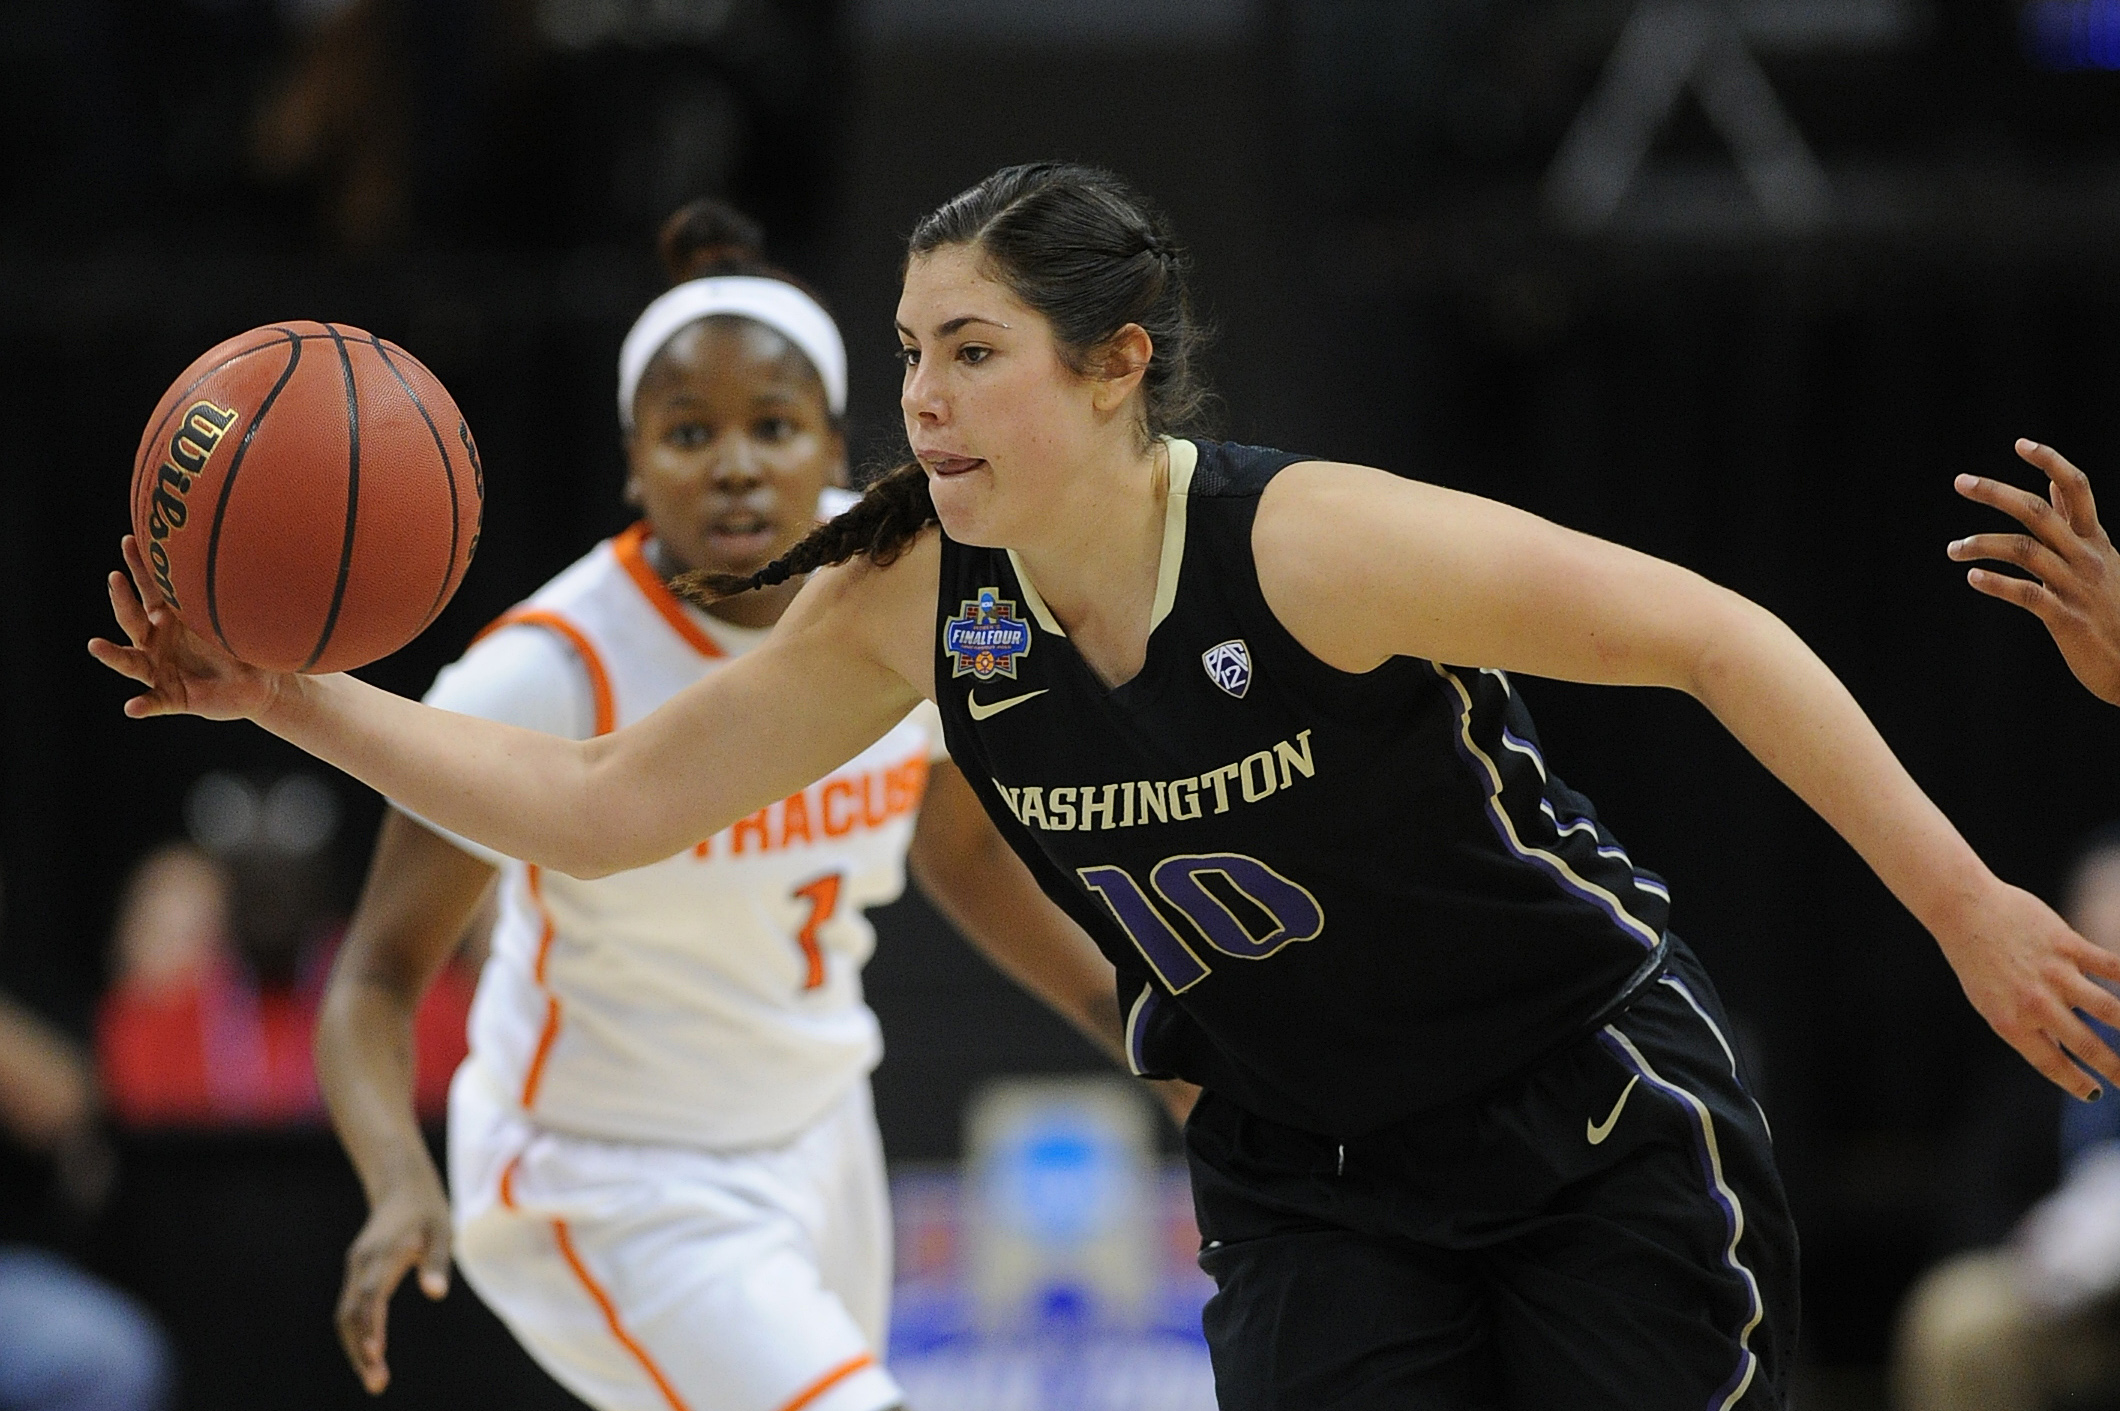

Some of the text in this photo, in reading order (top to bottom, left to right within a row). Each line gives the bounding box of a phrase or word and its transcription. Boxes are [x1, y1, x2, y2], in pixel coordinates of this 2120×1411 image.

[150, 400, 239, 611] Wilson
[952, 629, 1021, 645] FINAL FOUR
[1204, 643, 1249, 682] PAC
[1220, 665, 1247, 690] 12
[1076, 852, 1325, 996] 10
